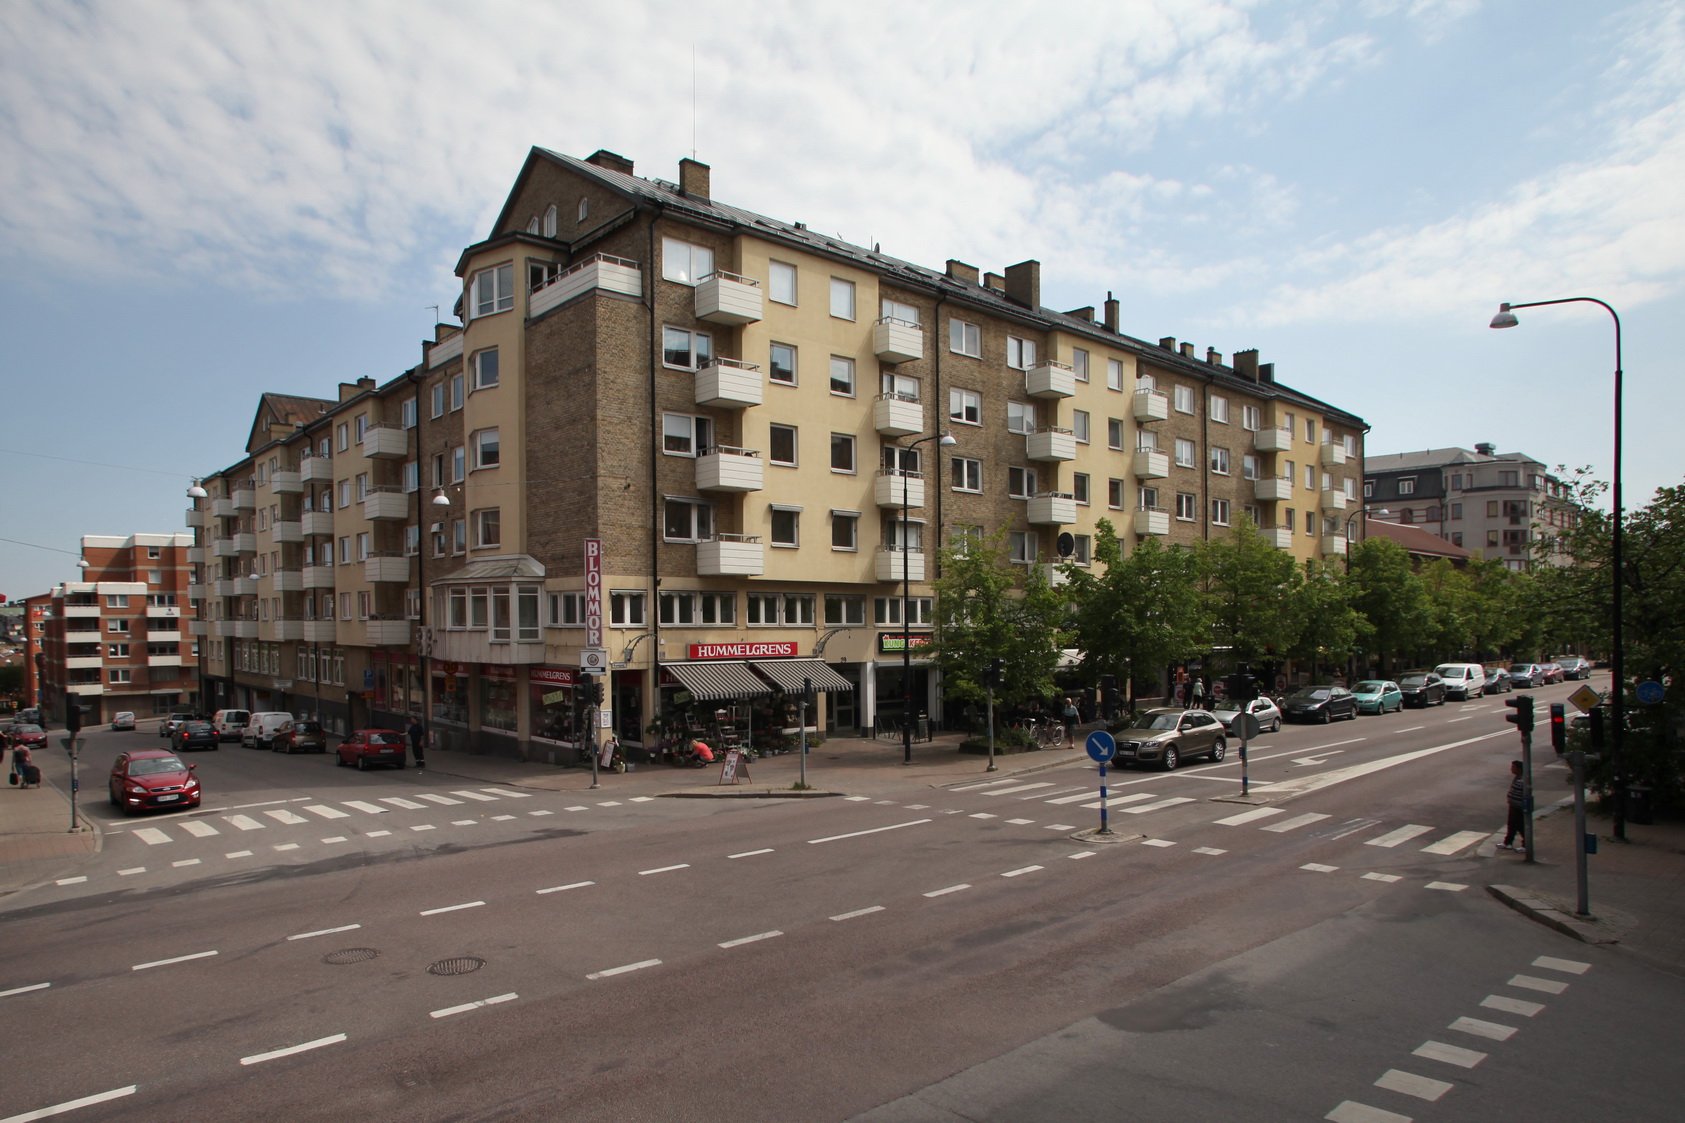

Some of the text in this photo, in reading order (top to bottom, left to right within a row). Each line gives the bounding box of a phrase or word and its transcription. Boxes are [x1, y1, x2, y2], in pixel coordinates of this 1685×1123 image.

[587, 541, 601, 645] BLOMMOR
[697, 643, 792, 657] HUMMELGRENS
[883, 638, 905, 648] KUNG
